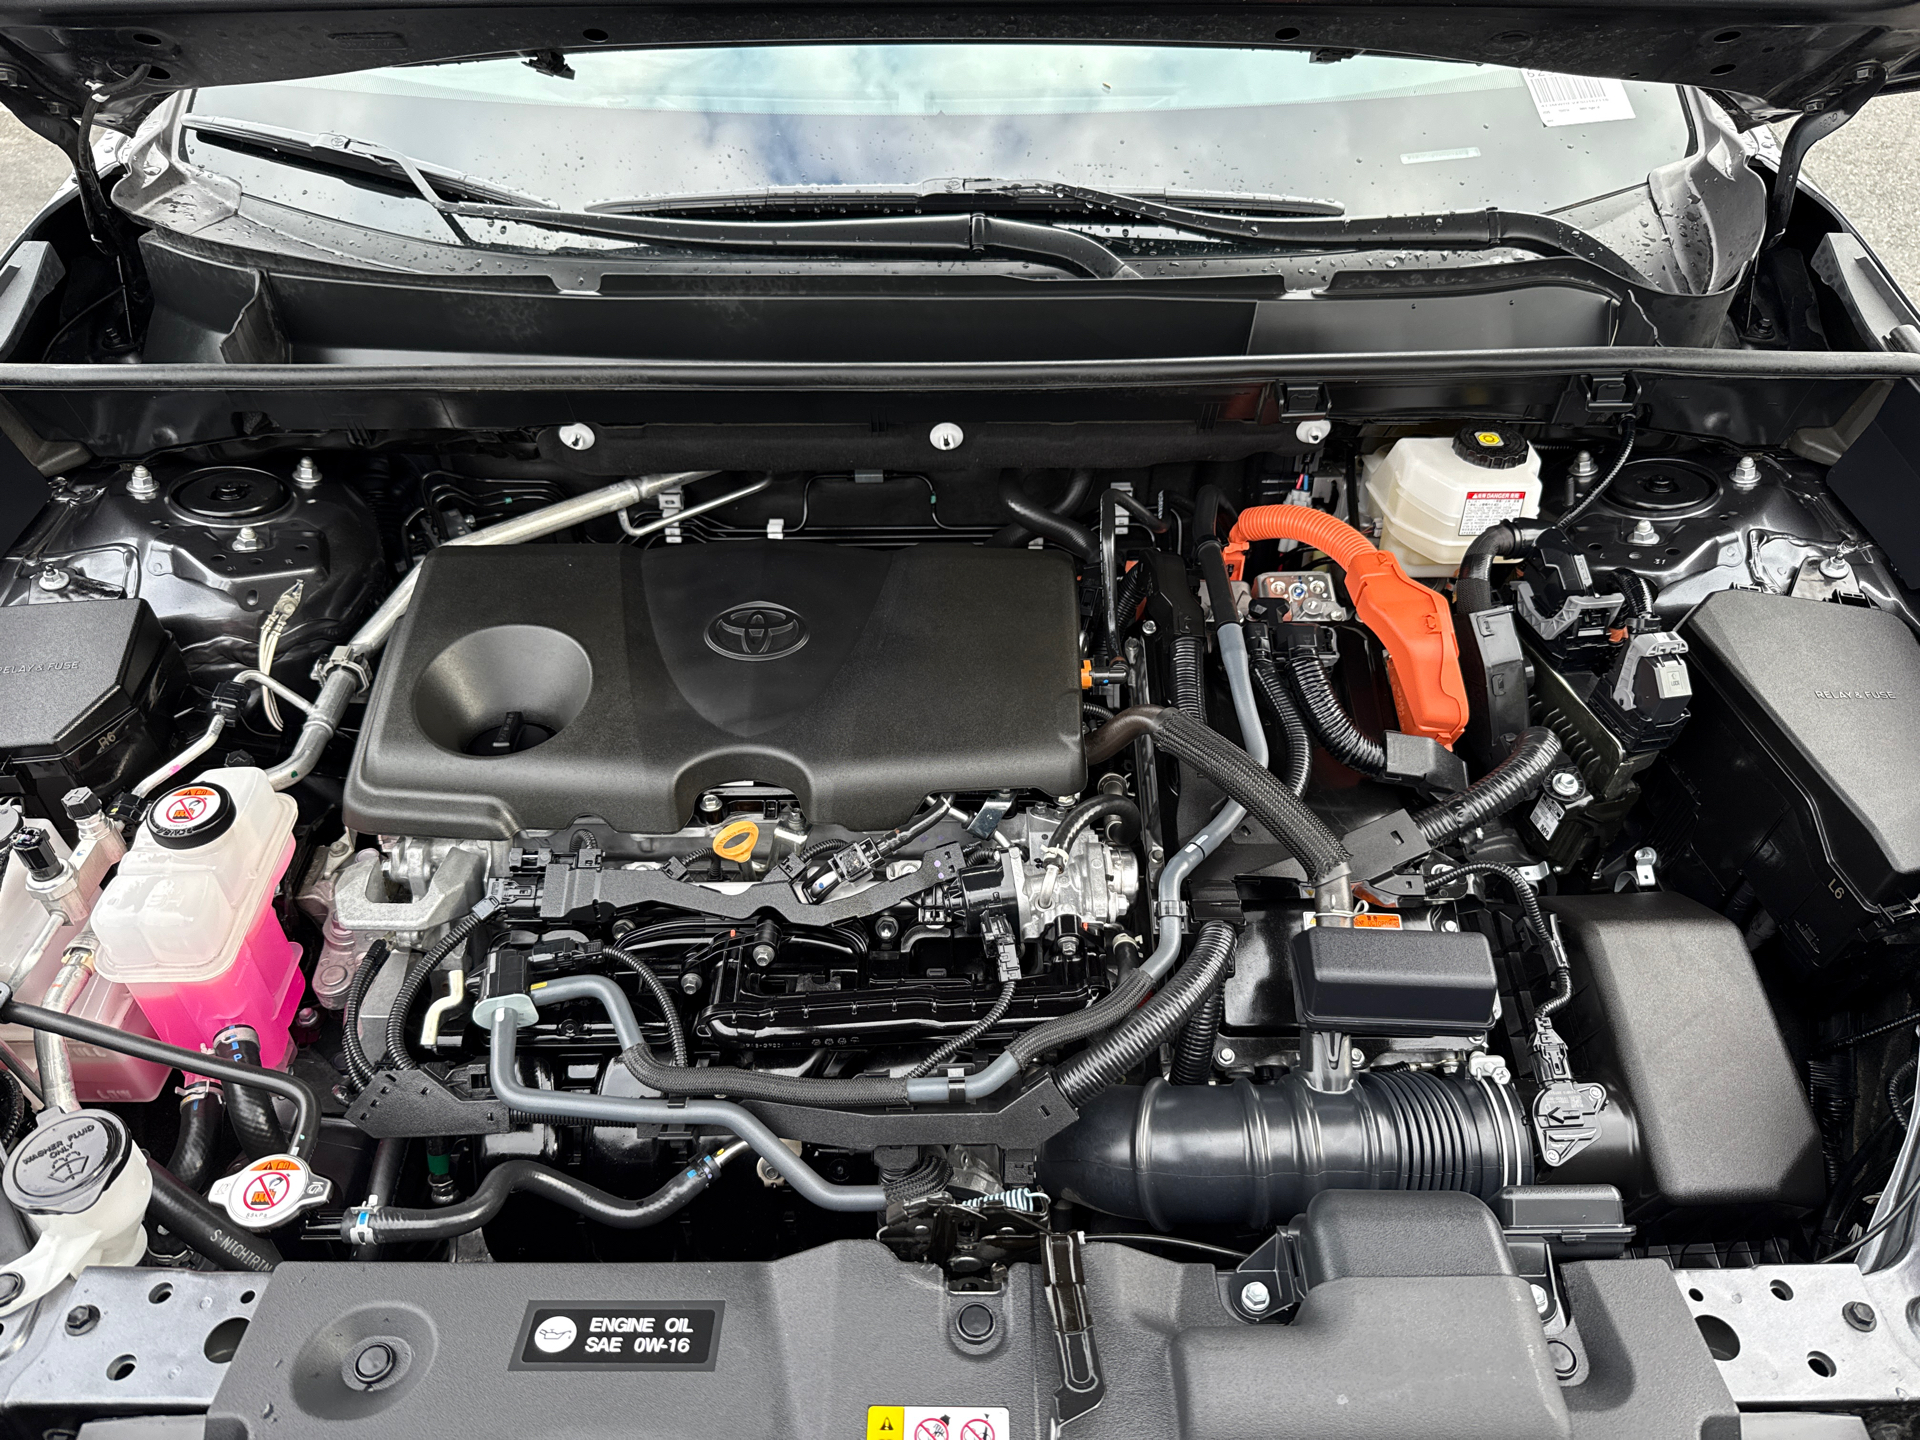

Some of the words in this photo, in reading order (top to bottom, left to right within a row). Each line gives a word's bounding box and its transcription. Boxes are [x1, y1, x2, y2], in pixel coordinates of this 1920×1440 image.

[36, 663, 45, 672] &
[47, 660, 80, 671] FUSE
[1814, 690, 1852, 700] RELAY
[1854, 691, 1863, 700] &
[1864, 691, 1897, 700] FUSE
[97, 731, 117, 750] R6
[1540, 823, 1550, 837] M9
[1827, 878, 1845, 899] L6
[96, 1089, 132, 1100] LOW
[22, 1140, 64, 1165] WASHER
[66, 1124, 95, 1142] FLUID
[49, 1141, 74, 1159] ONLY
[589, 1317, 655, 1333] ENGINE
[664, 1317, 693, 1333] OIL
[584, 1337, 623, 1353] SAE
[633, 1337, 690, 1353] 0W-16
